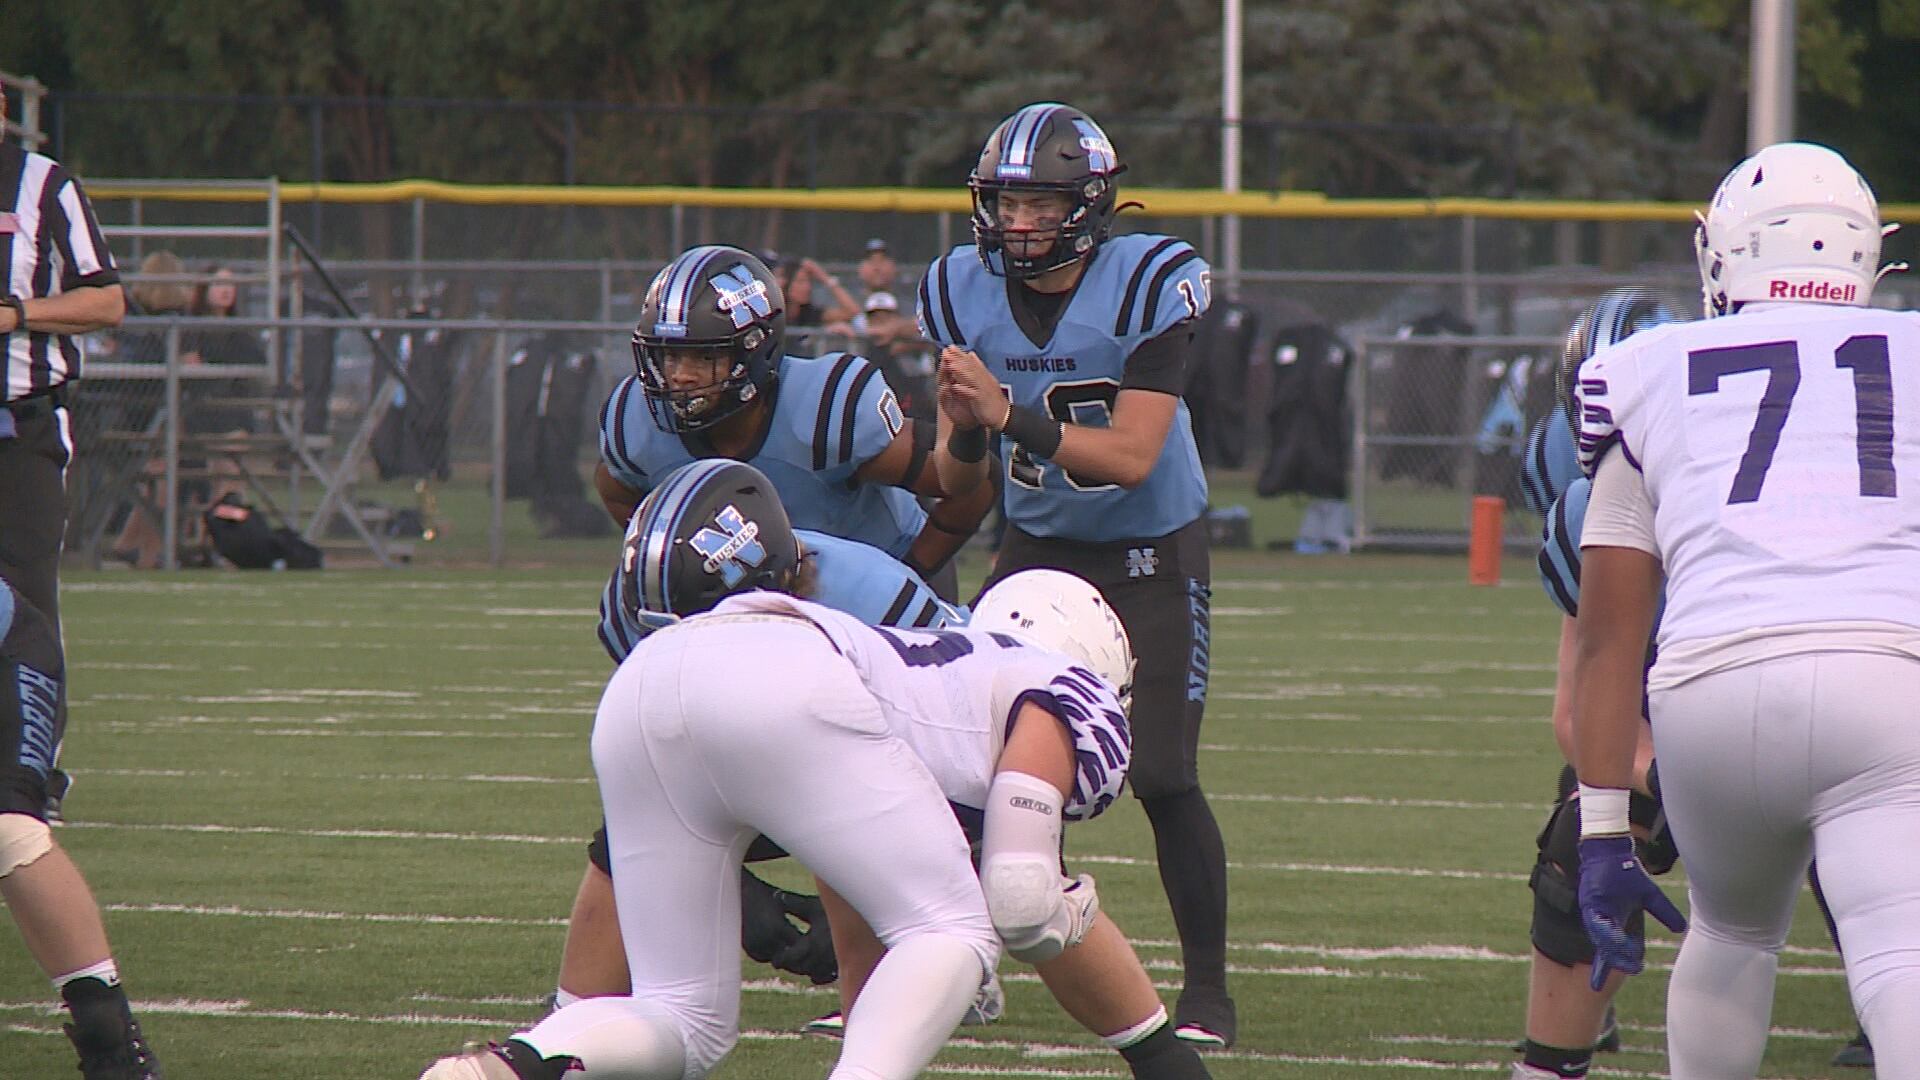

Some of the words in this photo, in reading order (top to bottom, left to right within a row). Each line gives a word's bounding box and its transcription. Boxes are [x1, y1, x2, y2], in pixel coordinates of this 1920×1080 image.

[1769, 280, 1857, 302] Riddell
[1005, 358, 1078, 372] HUSKIES
[1688, 335, 1897, 505] 71
[708, 525, 758, 569] HUSKIES
[18, 662, 58, 781] NORTH
